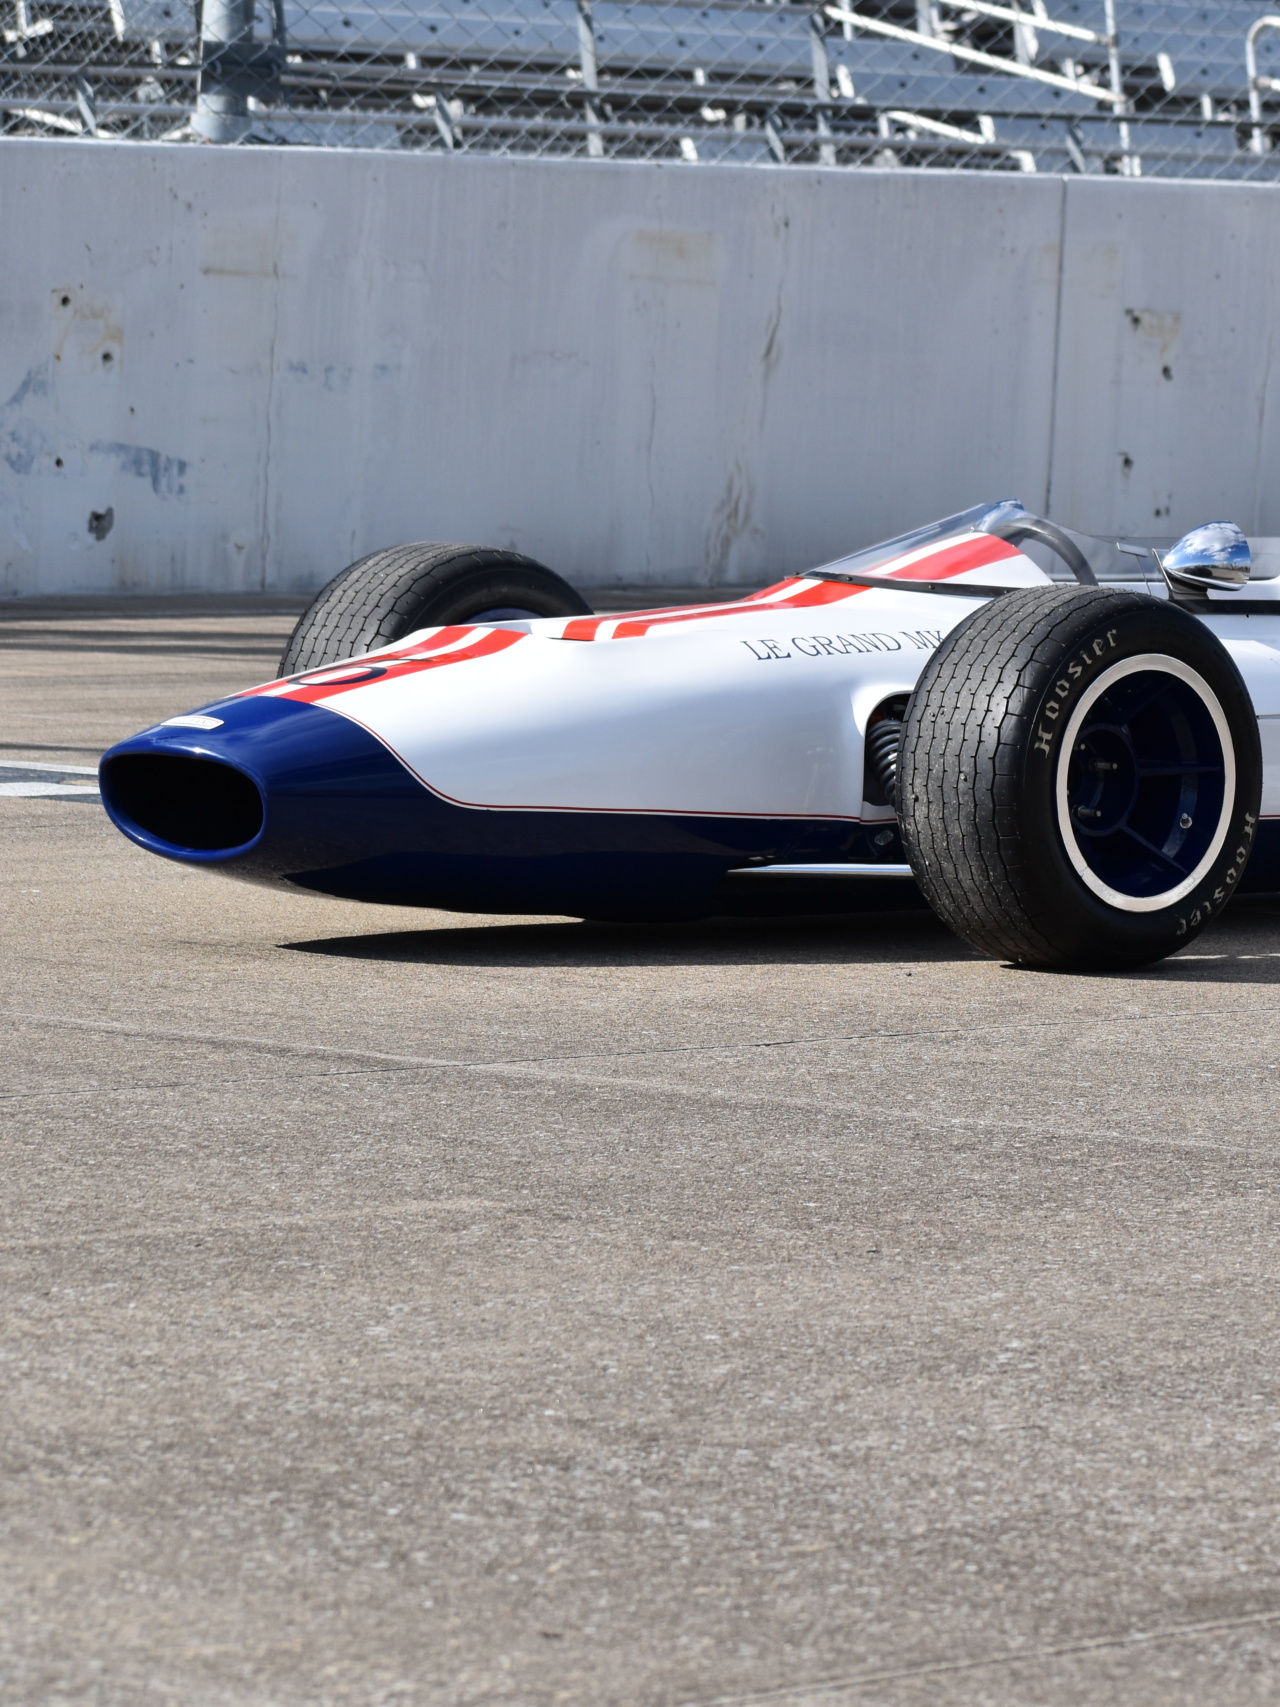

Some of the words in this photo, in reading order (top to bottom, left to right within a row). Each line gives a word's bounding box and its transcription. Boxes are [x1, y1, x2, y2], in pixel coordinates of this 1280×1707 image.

[740, 639, 792, 660] LE
[791, 633, 902, 657] GRAND
[1034, 629, 1117, 758] Hoosier
[1175, 812, 1256, 935] Hoosier
